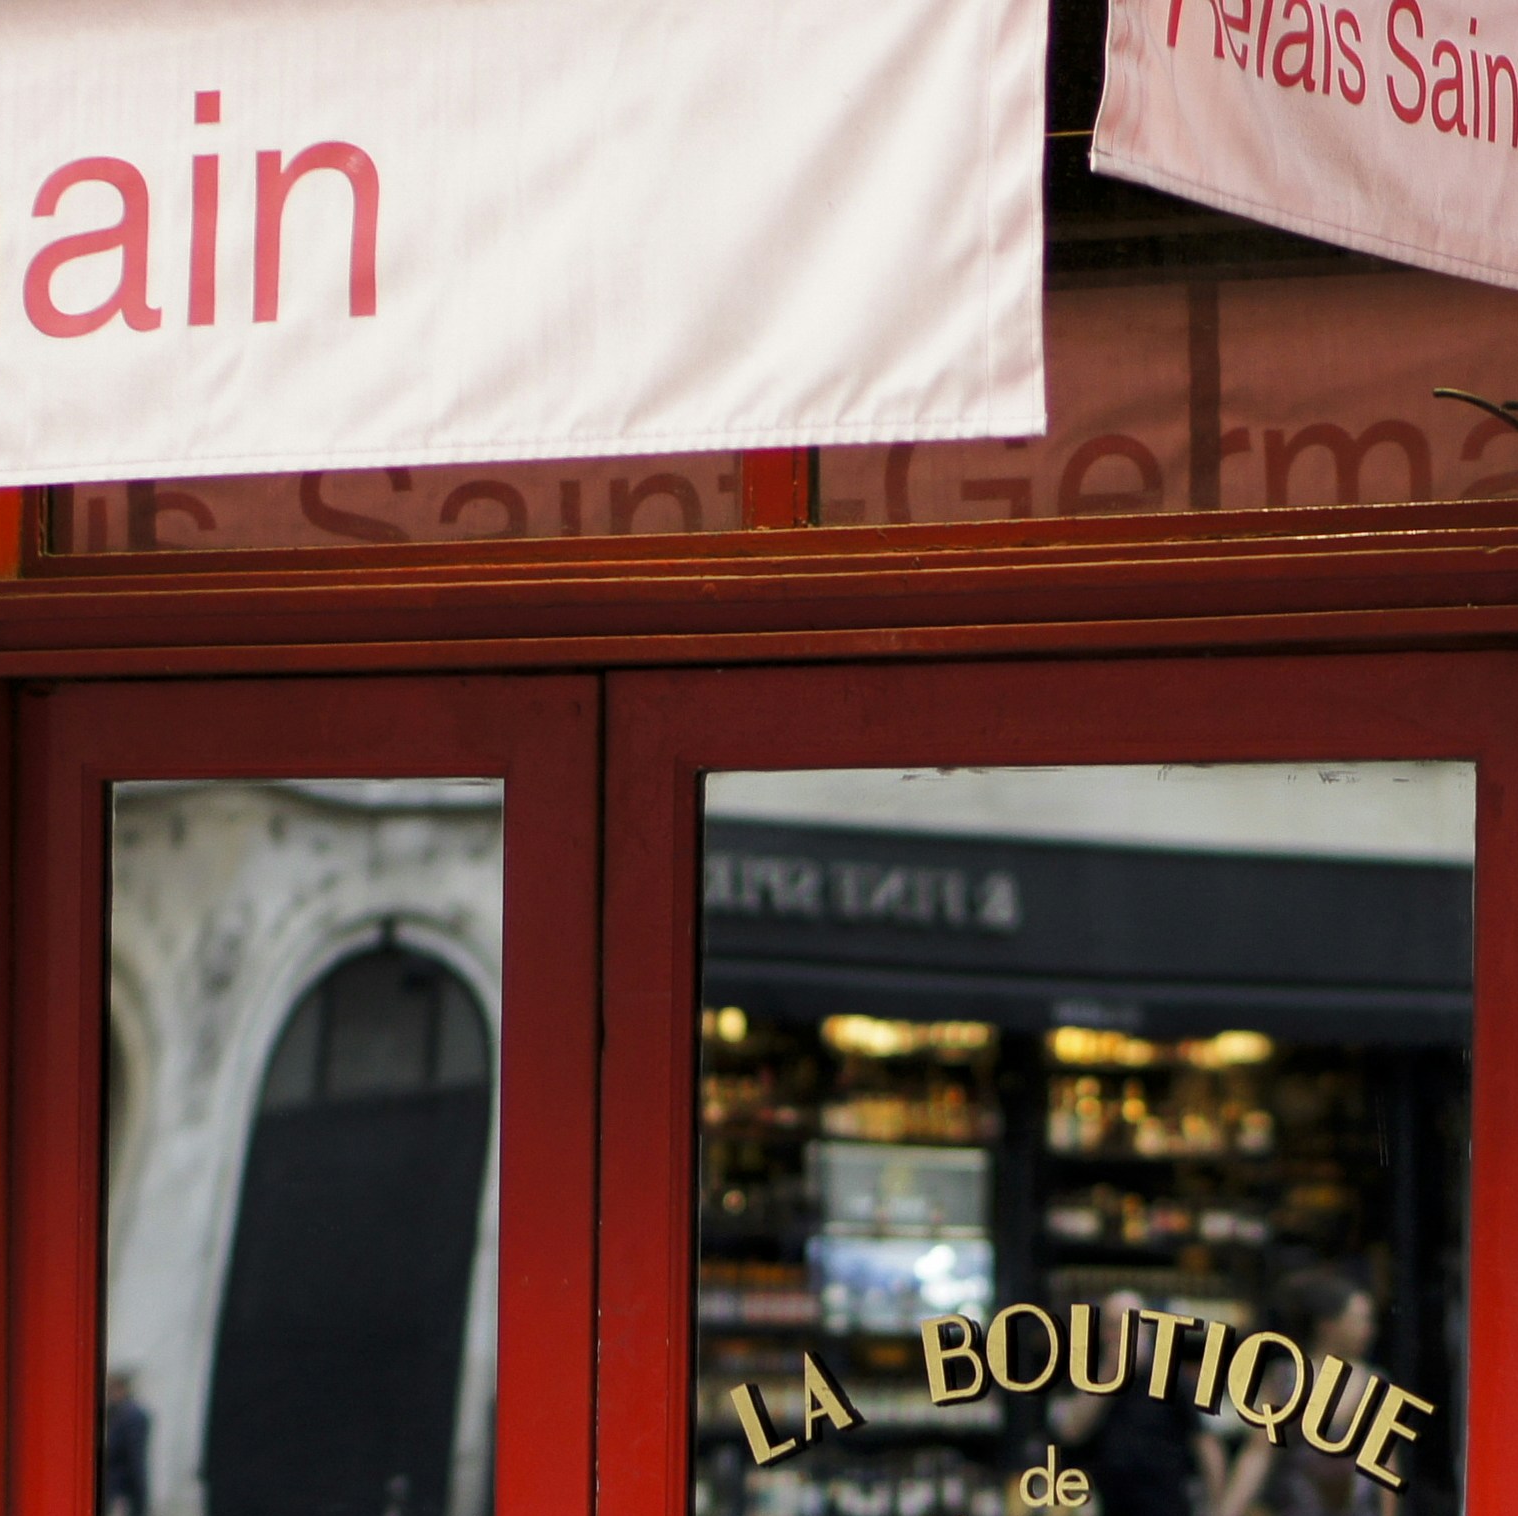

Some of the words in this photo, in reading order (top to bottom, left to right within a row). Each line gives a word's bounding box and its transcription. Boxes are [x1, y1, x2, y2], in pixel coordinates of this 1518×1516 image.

[730, 1351, 867, 1466] LA
[921, 1302, 1436, 1491] BOUTIQUE
[1019, 1444, 1092, 1507] de
